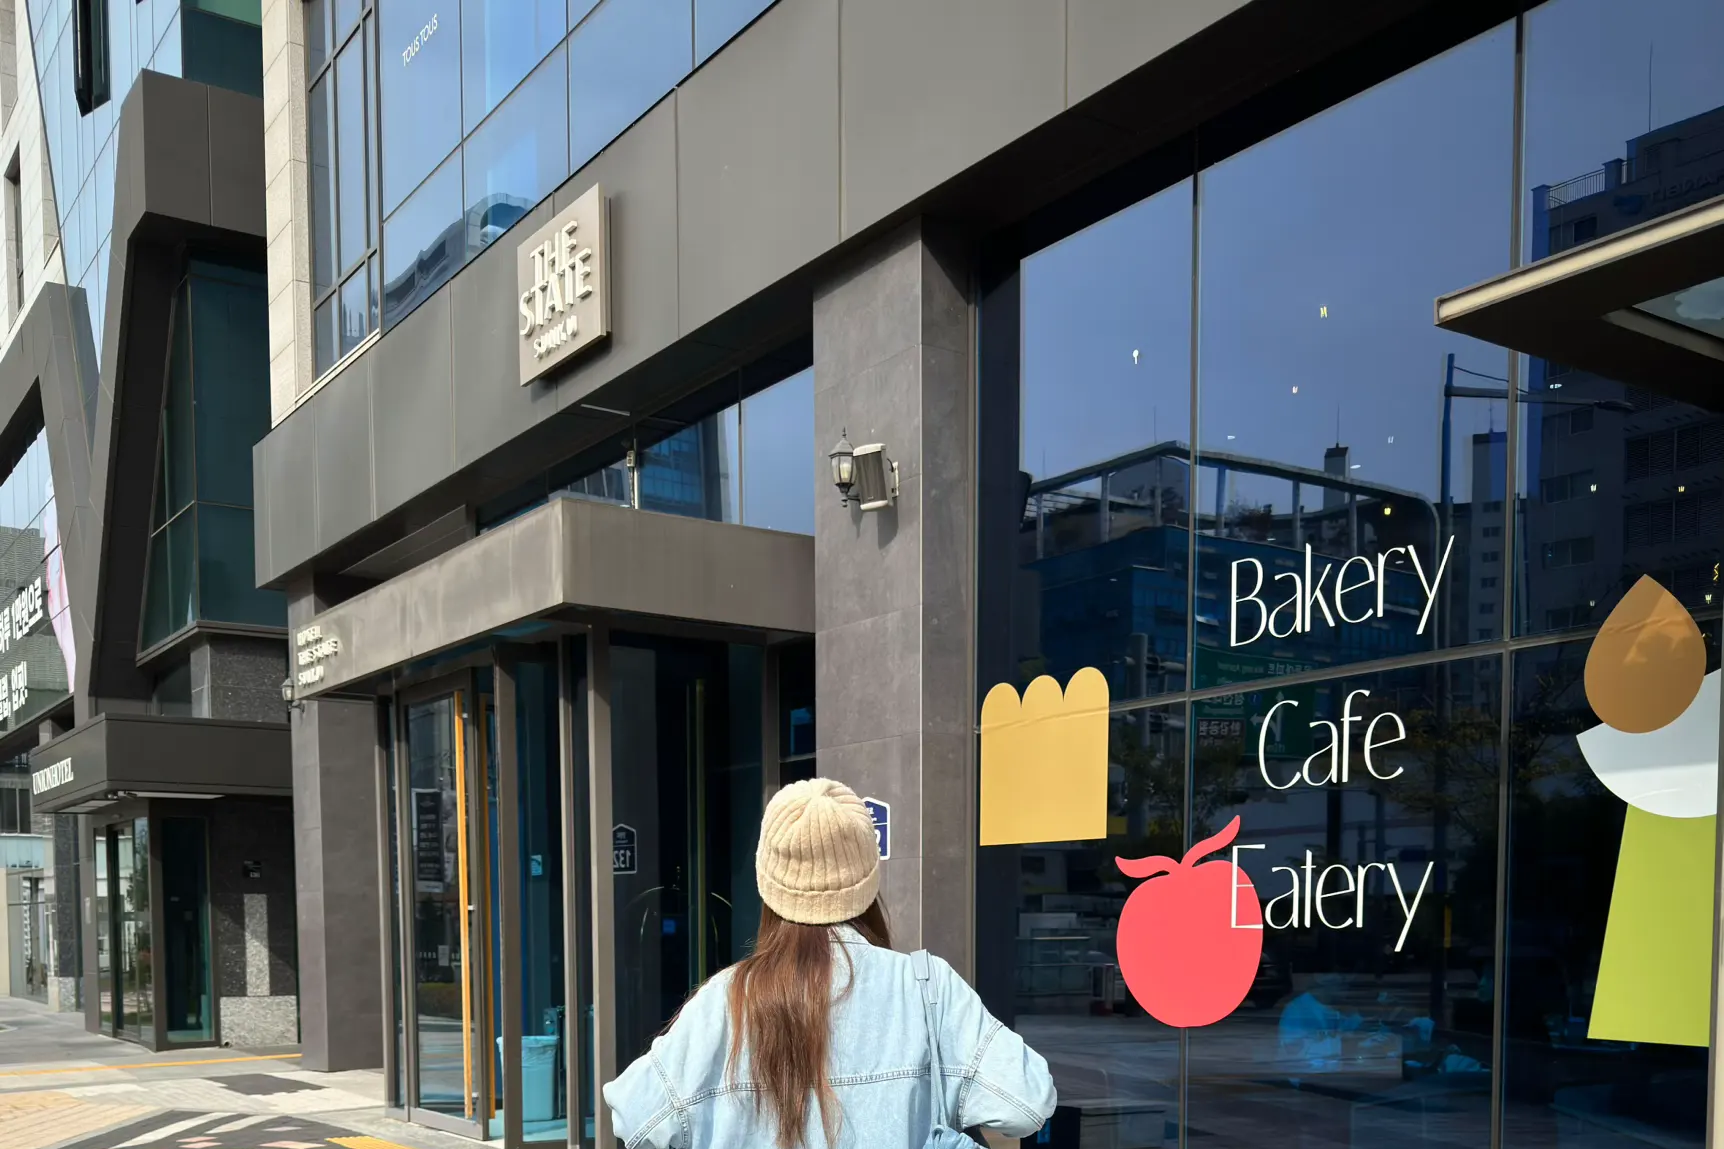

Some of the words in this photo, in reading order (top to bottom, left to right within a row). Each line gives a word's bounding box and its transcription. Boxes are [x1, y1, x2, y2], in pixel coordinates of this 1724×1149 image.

[402, 36, 420, 67] TOUS
[420, 13, 438, 46] TOUS
[519, 248, 592, 336] STATE
[530, 221, 577, 283] THE
[11, 576, 43, 641] 1만원으로
[1230, 535, 1455, 647] Bakery
[1258, 689, 1406, 790] Cafe
[1230, 843, 1434, 952] Eatery
